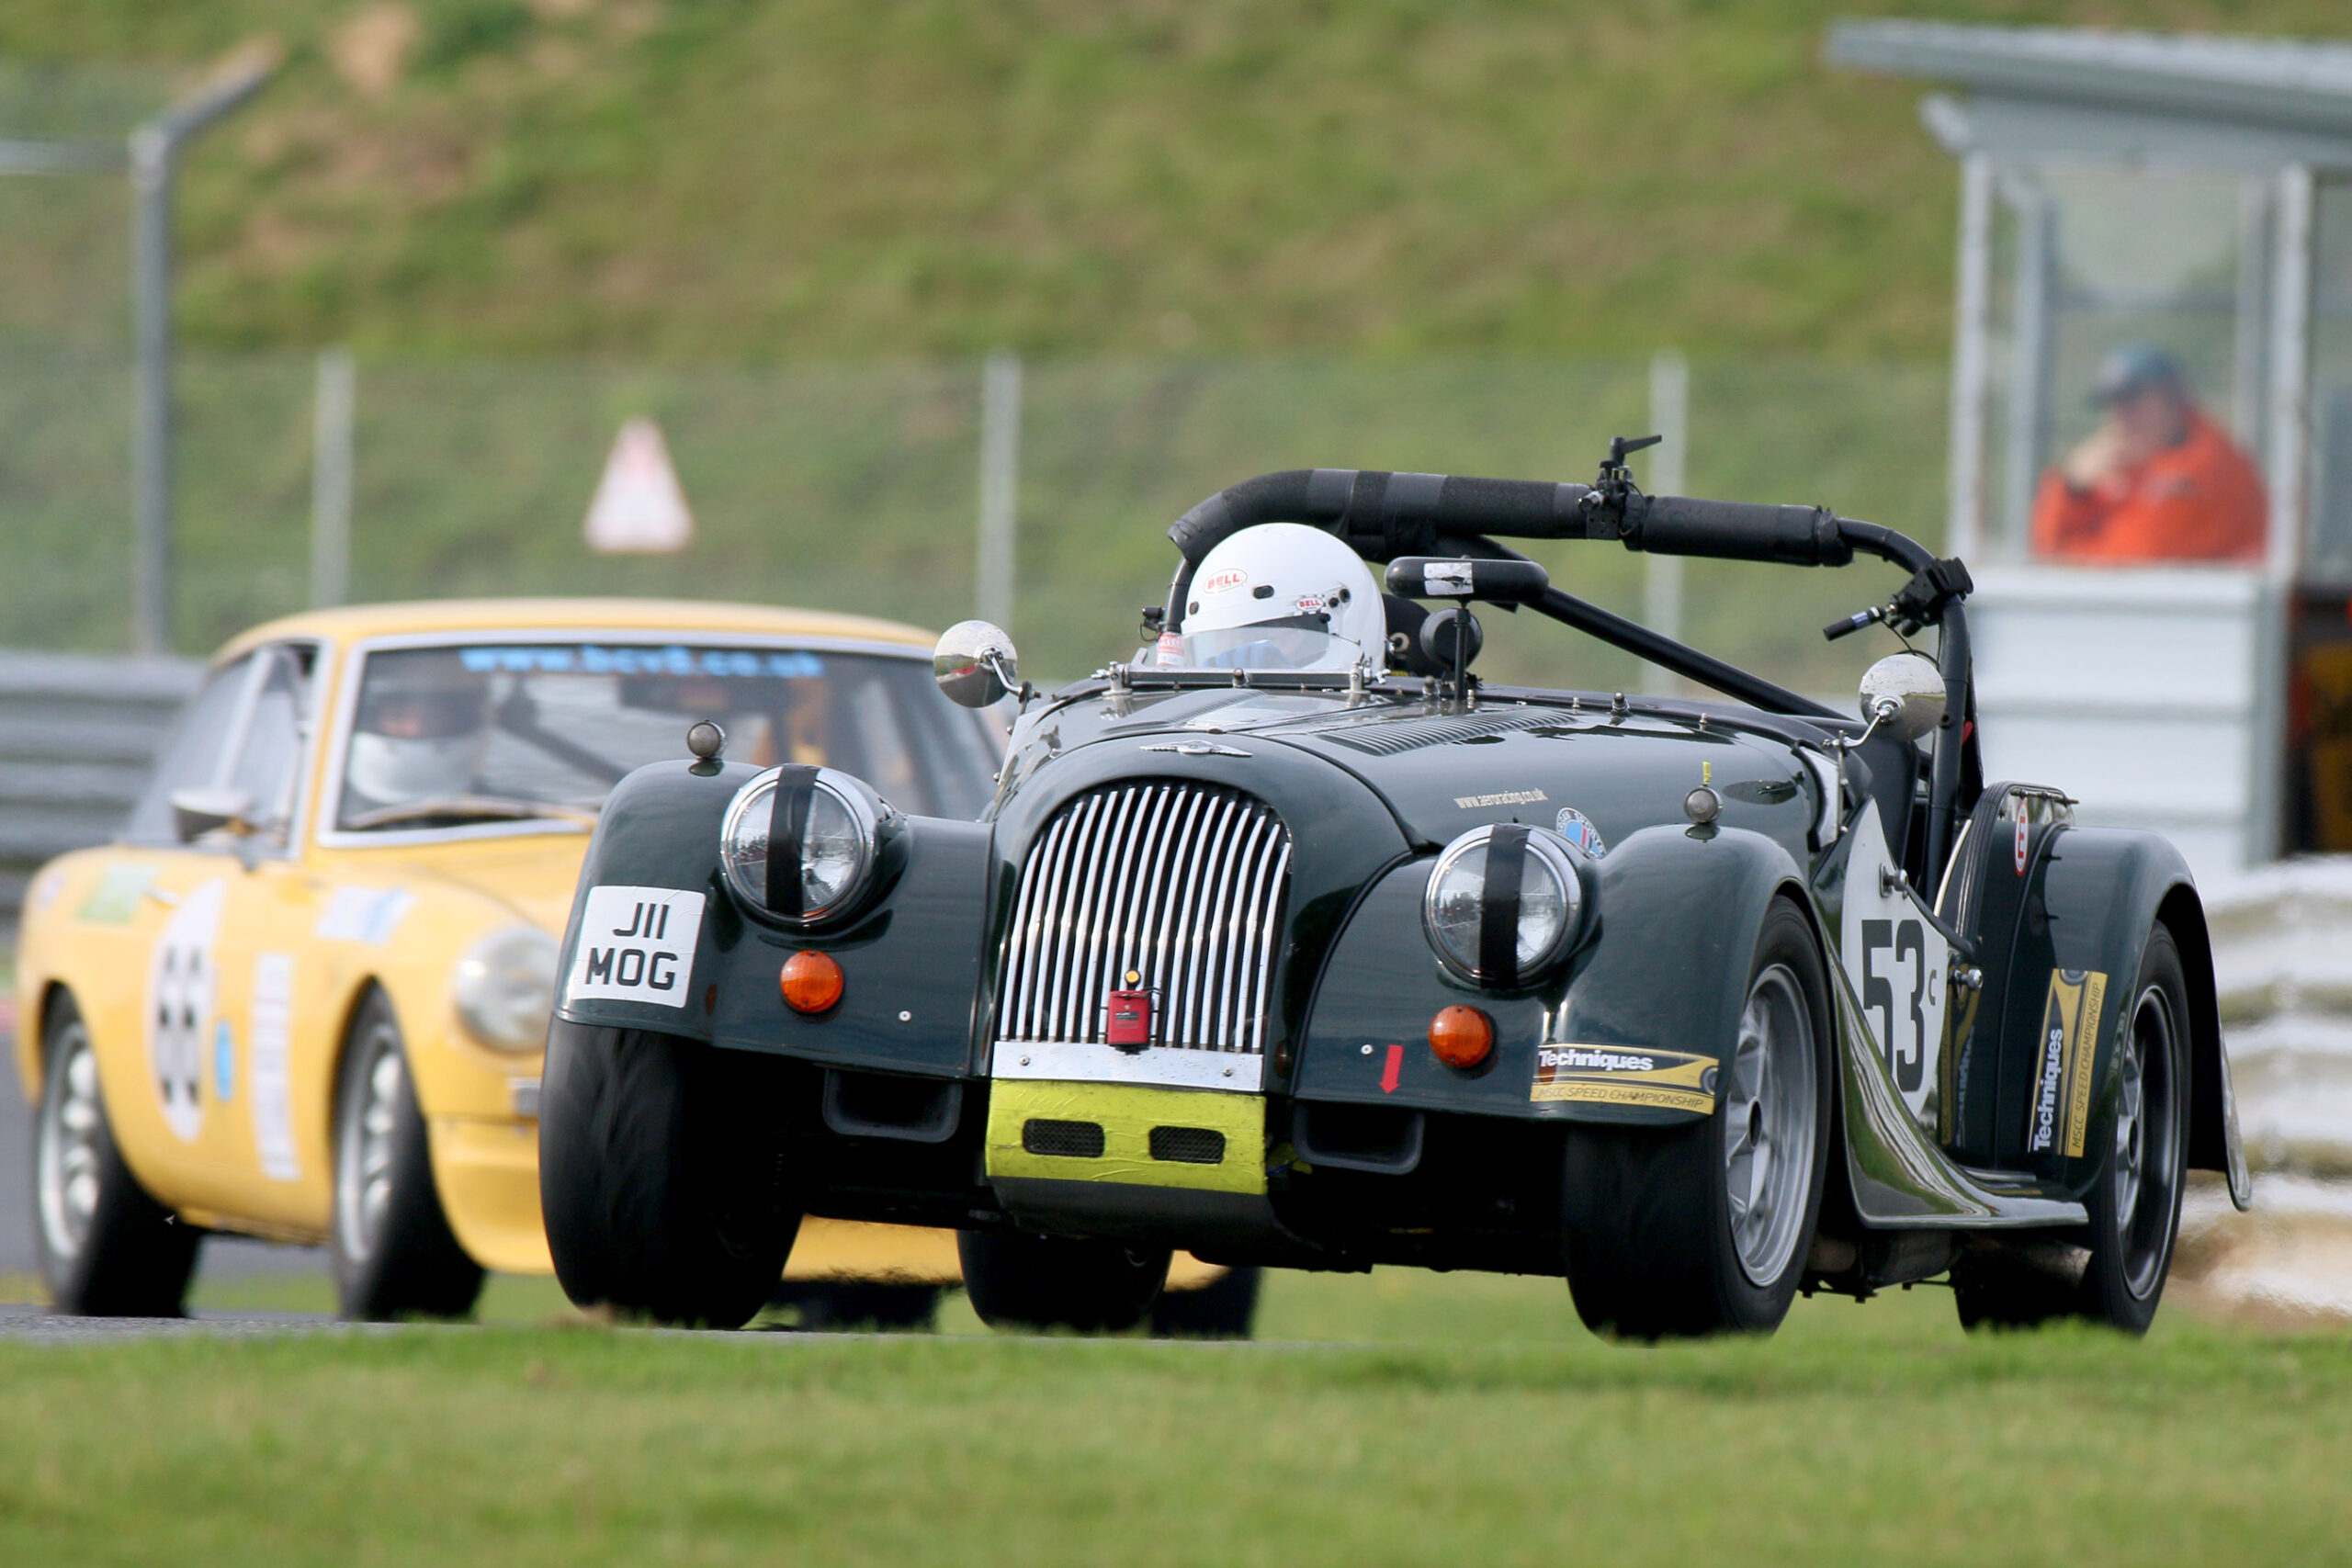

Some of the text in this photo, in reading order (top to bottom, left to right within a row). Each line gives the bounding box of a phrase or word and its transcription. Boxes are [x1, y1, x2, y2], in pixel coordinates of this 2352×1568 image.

[1207, 573, 1240, 590] BELL
[1299, 599, 1321, 608] BELL
[2018, 815, 2026, 859] E
[584, 947, 679, 990] MOG
[1861, 919, 1926, 1092] 53
[1538, 1049, 1654, 1071] Techniques
[2073, 982, 2103, 1148] MSCC SPEED CHAMPIONSHIP
[1537, 1087, 1704, 1108] MSCC SPEED CHAMPIONSHIP
[2033, 1028, 2064, 1152] Techniques
